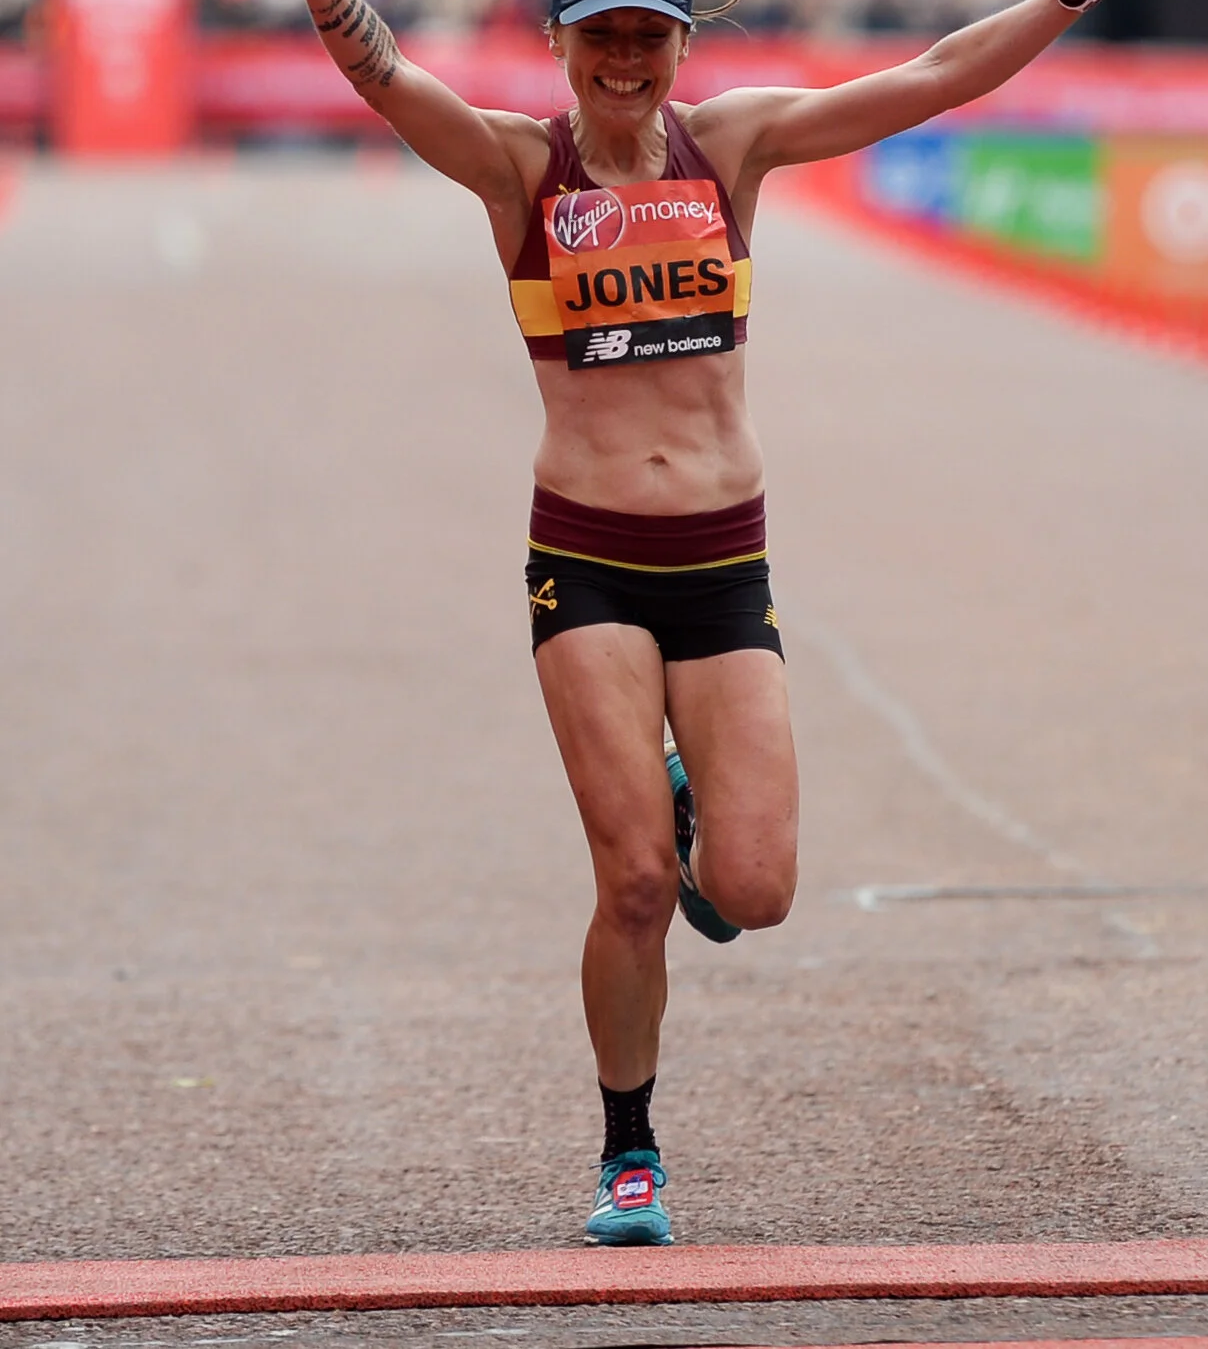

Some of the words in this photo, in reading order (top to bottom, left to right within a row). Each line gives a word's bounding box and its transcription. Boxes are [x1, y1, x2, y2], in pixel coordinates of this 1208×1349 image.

[557, 193, 618, 247] Virgin
[630, 200, 715, 224] money
[565, 257, 729, 312] JONES
[634, 340, 665, 357] new
[667, 335, 722, 353] balance
